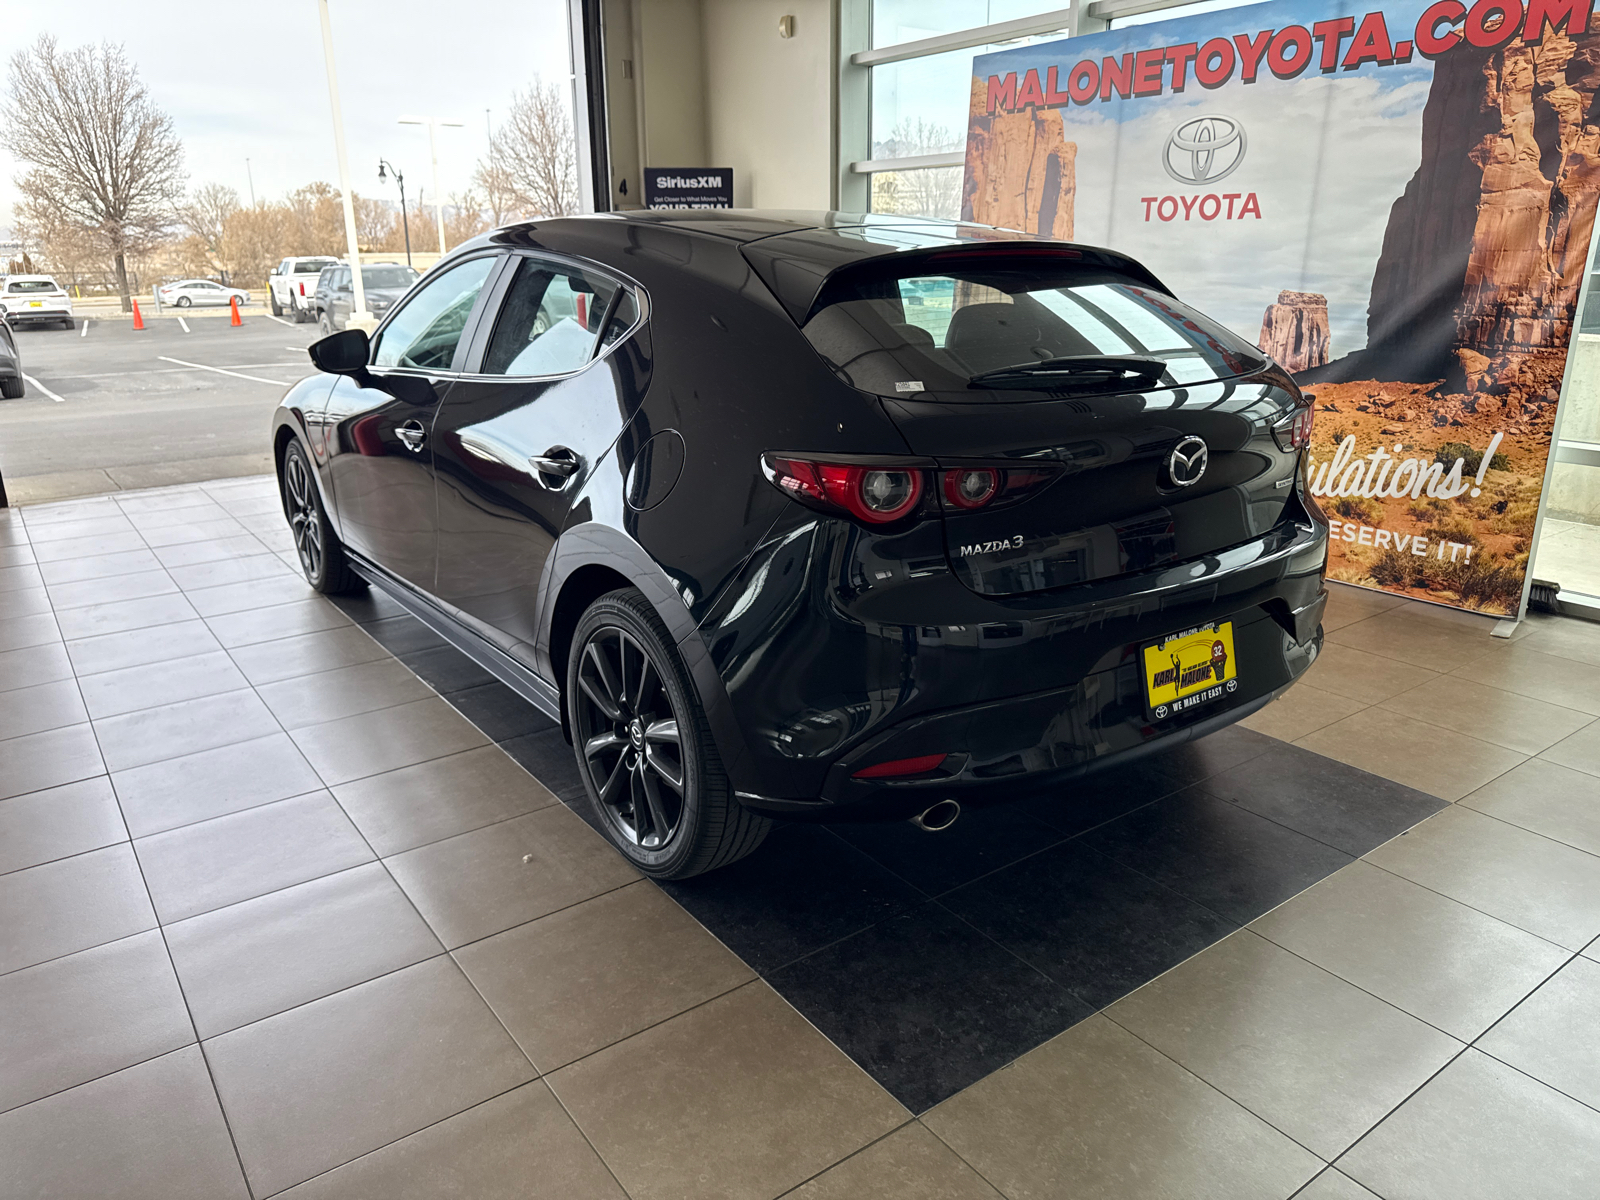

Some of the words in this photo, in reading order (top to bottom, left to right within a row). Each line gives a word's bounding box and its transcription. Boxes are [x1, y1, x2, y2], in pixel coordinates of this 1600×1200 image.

[986, 0, 1594, 116] MALONETOYOTA.COM
[619, 178, 627, 196] 4
[656, 176, 722, 189] SiriusXM
[1141, 192, 1262, 223] TOYOTA
[1308, 432, 1504, 500] ulations!
[1328, 519, 1429, 557] ESERVE
[1436, 540, 1473, 565] IT!
[1165, 634, 1178, 643] KARL
[1213, 645, 1223, 657] 32
[1154, 668, 1176, 689] KARL
[1180, 665, 1211, 689] MALONE
[1172, 701, 1183, 712] WE
[1183, 696, 1200, 708] MAKE
[1201, 692, 1208, 702] IT
[1208, 686, 1222, 699] EASY
